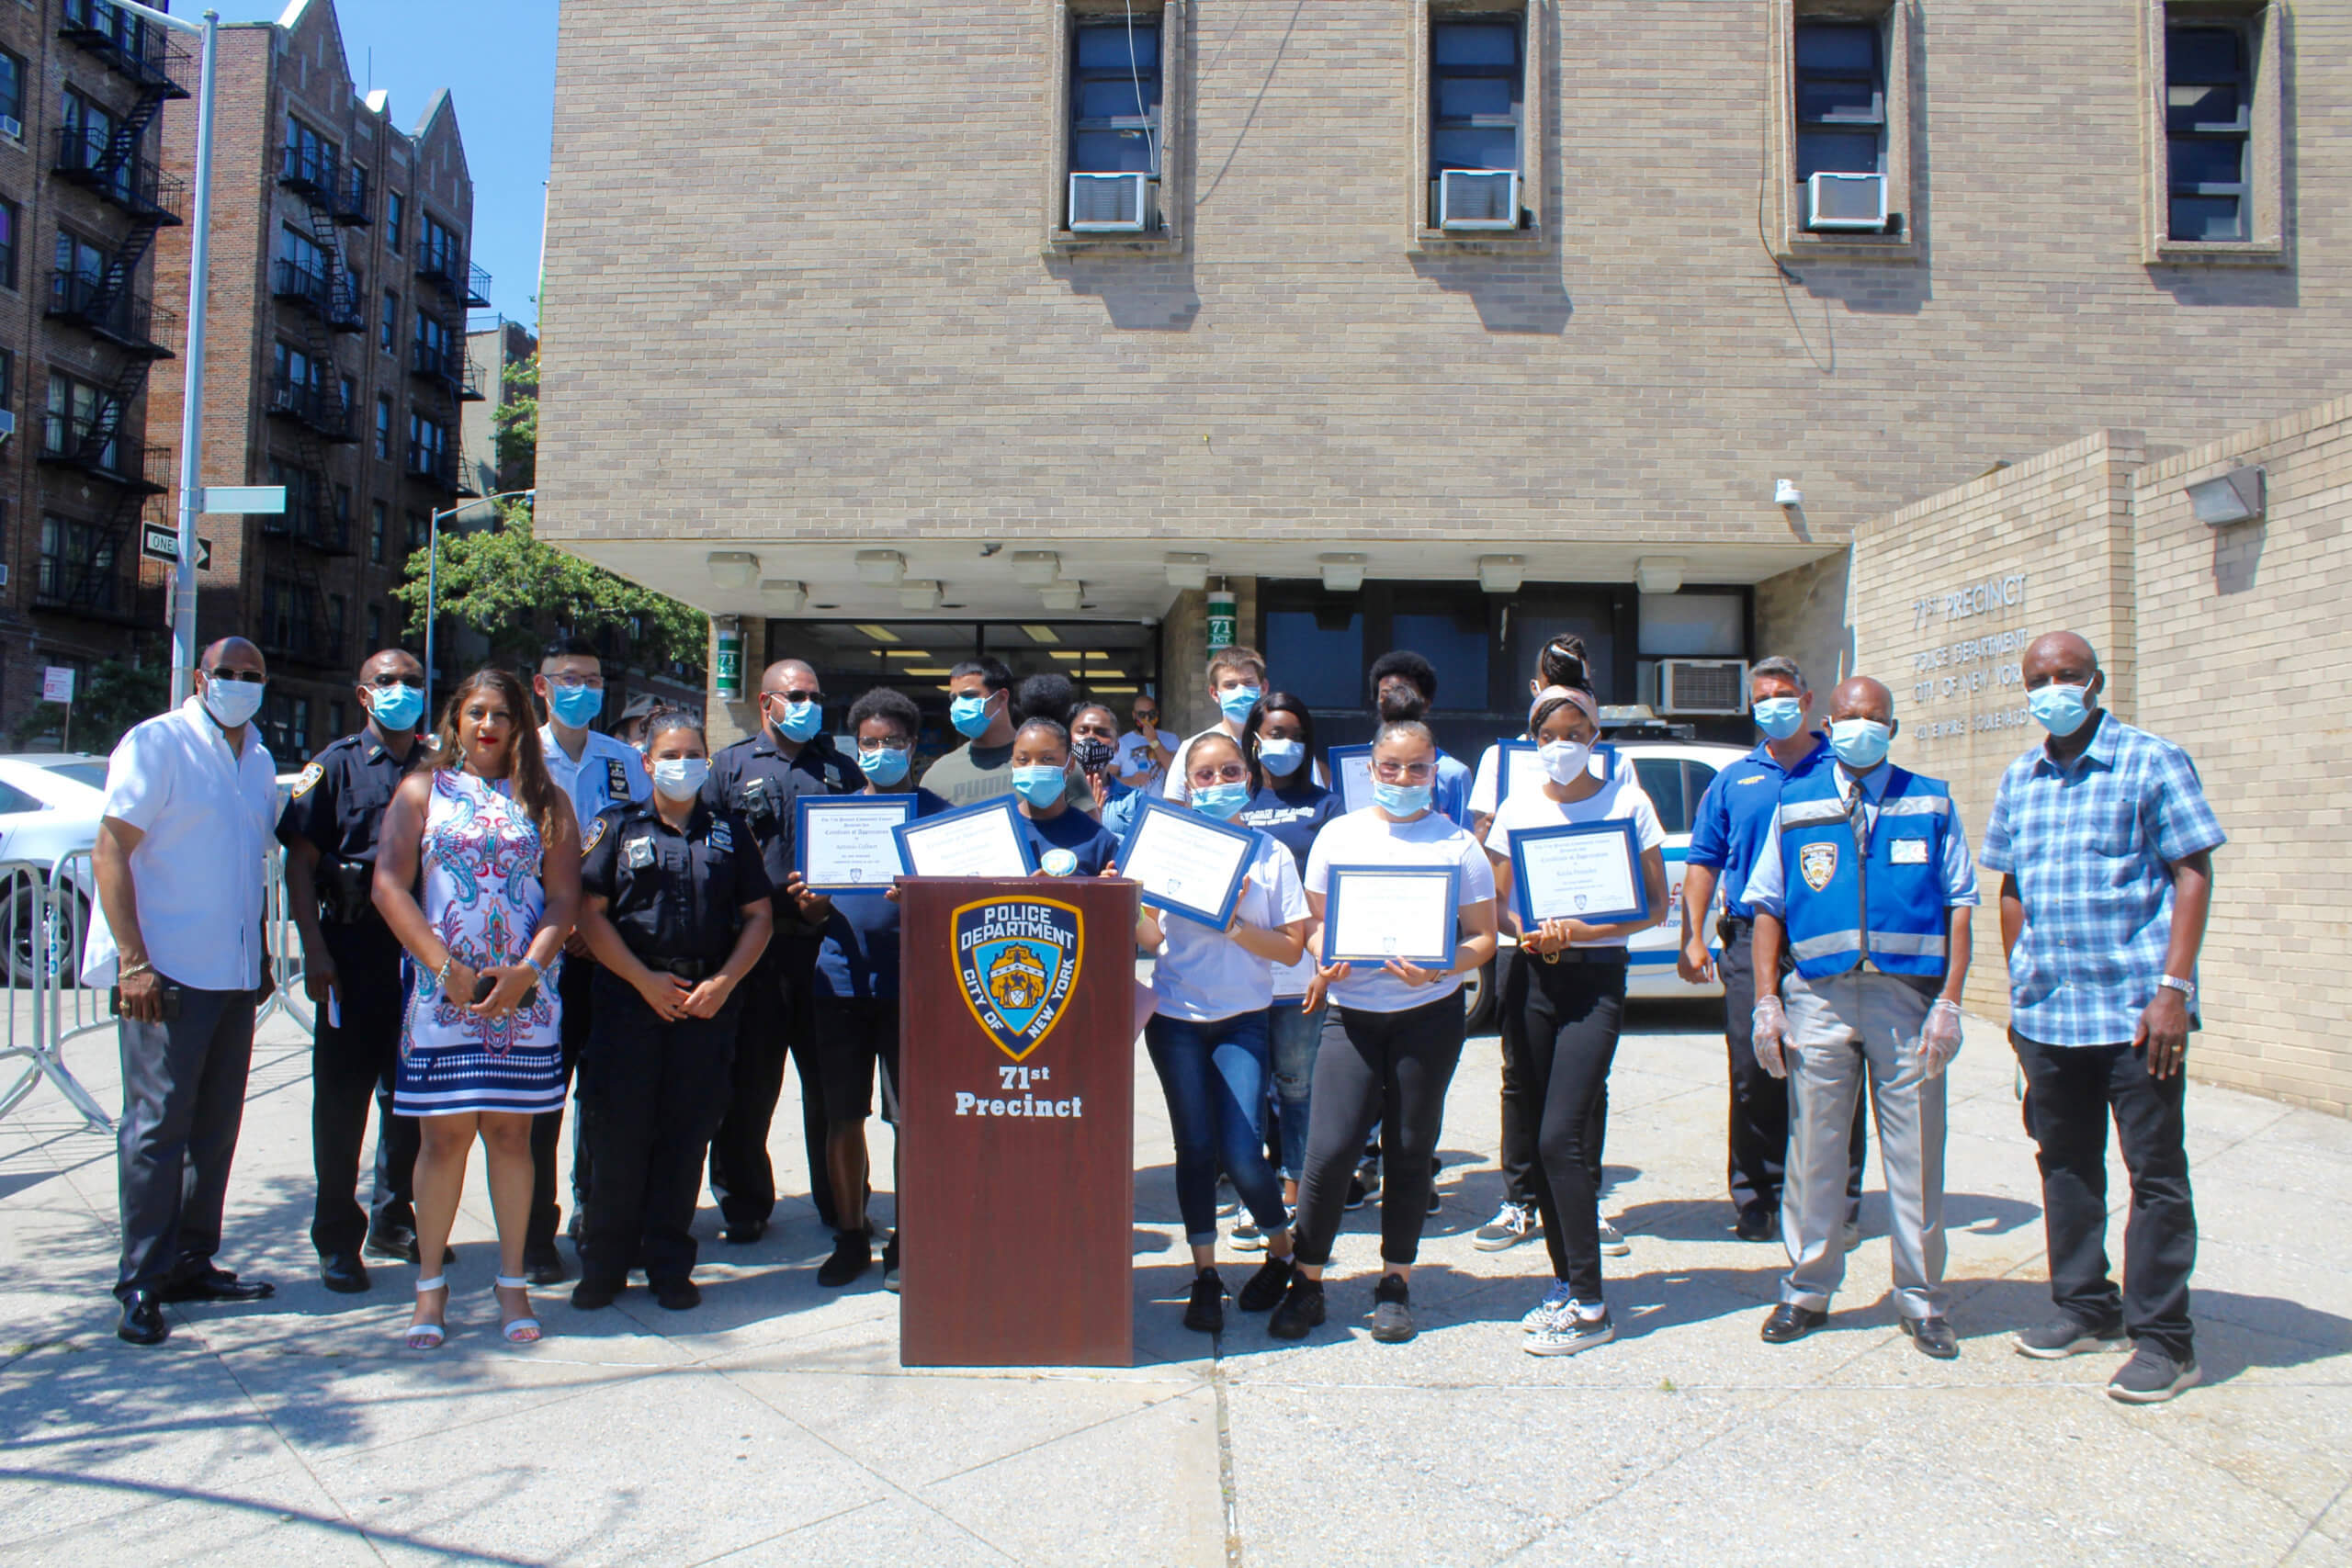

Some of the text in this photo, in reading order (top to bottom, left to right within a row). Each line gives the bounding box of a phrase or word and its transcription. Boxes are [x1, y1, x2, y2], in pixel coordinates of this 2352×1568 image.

[153, 536, 174, 552] ONE
[1944, 574, 2026, 621] PRECINCT
[1212, 621, 1230, 634] 71
[720, 654, 735, 666] 71
[1914, 628, 2027, 672] POLICE DEPARTMENT
[1914, 665, 2022, 704] CITY OF NEW YOR
[1973, 707, 2029, 732] BOULEVARD
[985, 905, 1052, 924] POLICE
[961, 921, 1074, 952] DEPARTMENT
[963, 959, 1075, 1039] CITY OF NEW YORK
[999, 1066, 1050, 1089] 71st
[955, 1091, 1082, 1118] Precinct
